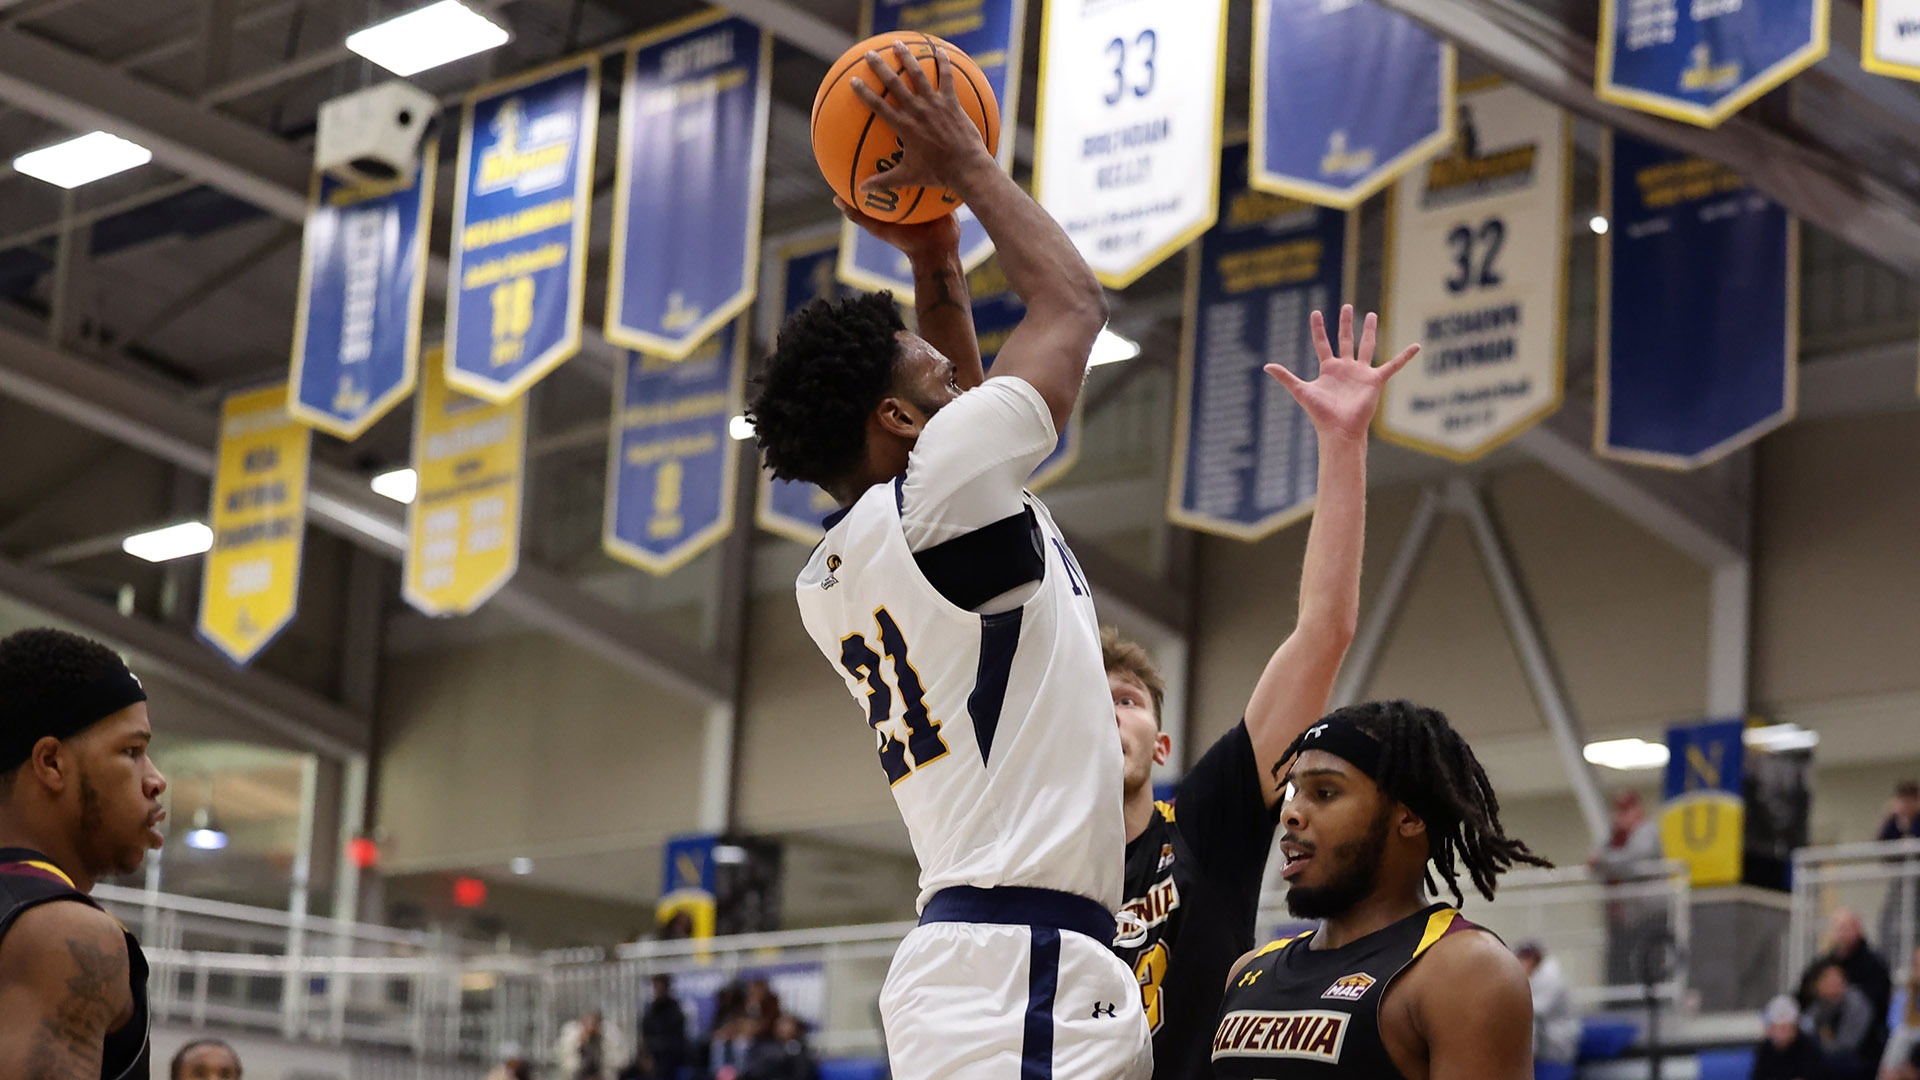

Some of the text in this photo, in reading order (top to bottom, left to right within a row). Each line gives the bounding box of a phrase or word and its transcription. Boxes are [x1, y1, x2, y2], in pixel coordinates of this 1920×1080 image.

[1105, 29, 1157, 106] 33
[1445, 217, 1504, 294] 32
[840, 604, 951, 788] 21
[1326, 984, 1367, 998] MAC
[1213, 1015, 1343, 1056] ALVERNIA
